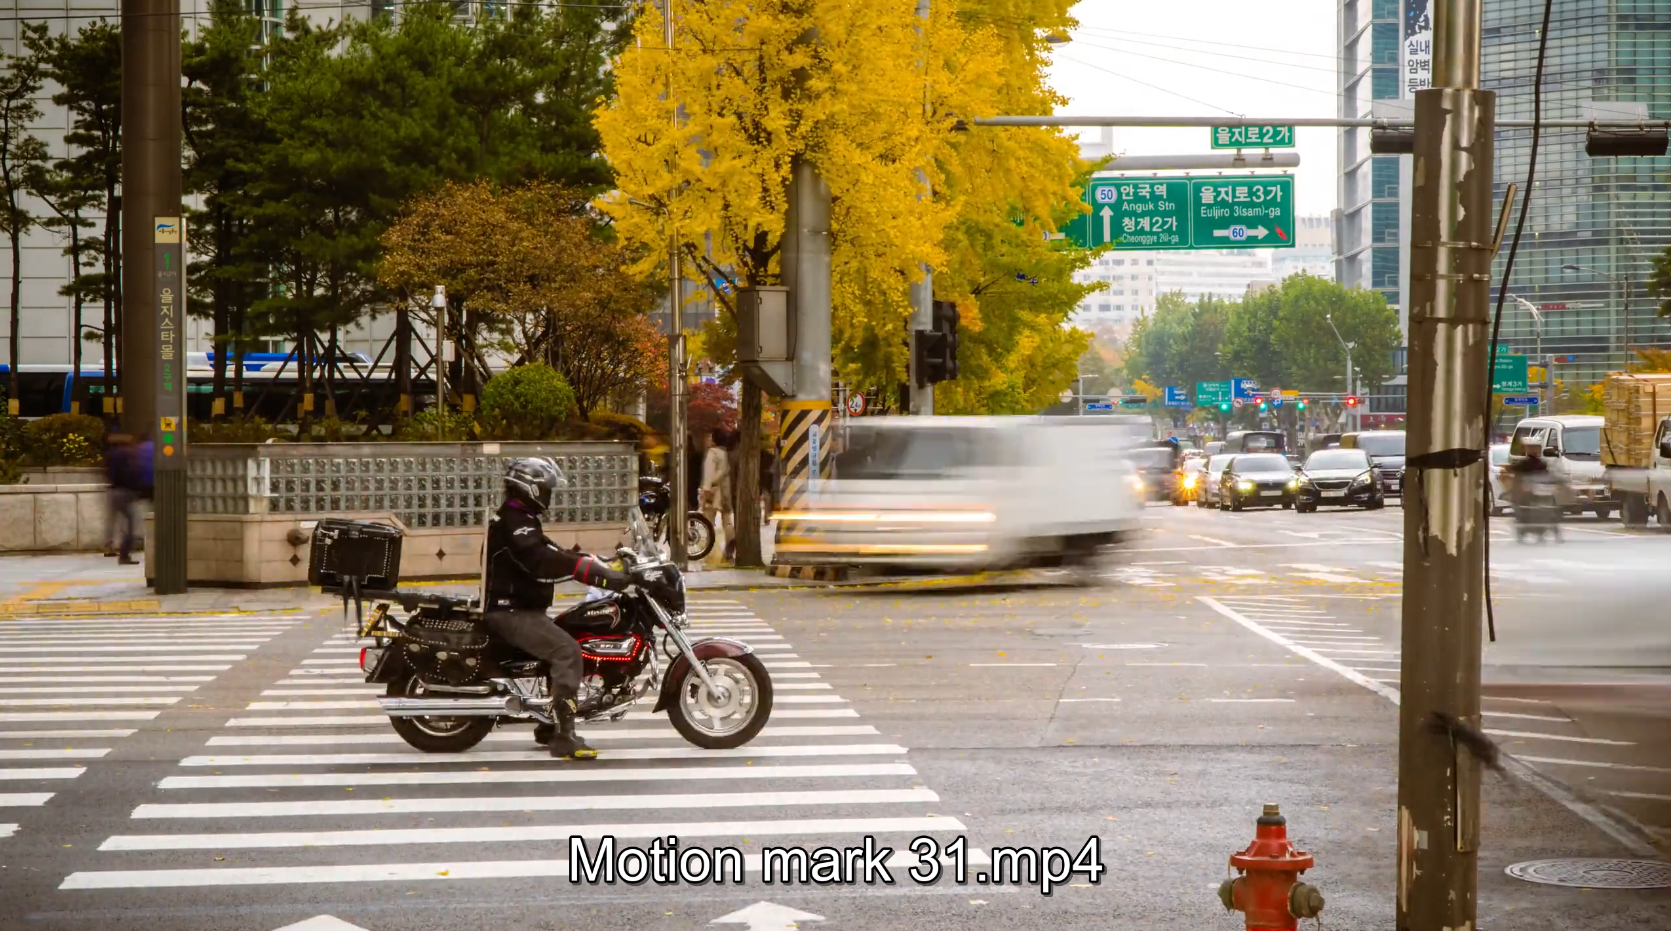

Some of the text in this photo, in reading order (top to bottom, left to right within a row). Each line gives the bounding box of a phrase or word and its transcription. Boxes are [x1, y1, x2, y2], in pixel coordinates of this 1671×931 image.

[1407, 39, 1430, 55] 실내
[1407, 58, 1430, 74] 암벽
[1216, 125, 1290, 144] 을지로2가
[1100, 189, 1114, 201] 50
[1120, 183, 1167, 199] 안국역
[1199, 184, 1283, 204] 을지로3가
[1122, 200, 1175, 213] Anguk Stn
[1201, 205, 1281, 219] Euljiro 3(sam)-ga
[1122, 215, 1178, 232] 청계2가
[1122, 233, 1157, 244] Cheonggye
[1232, 228, 1244, 238] 60
[163, 252, 170, 270] 1
[160, 288, 175, 360] 을지스타몰
